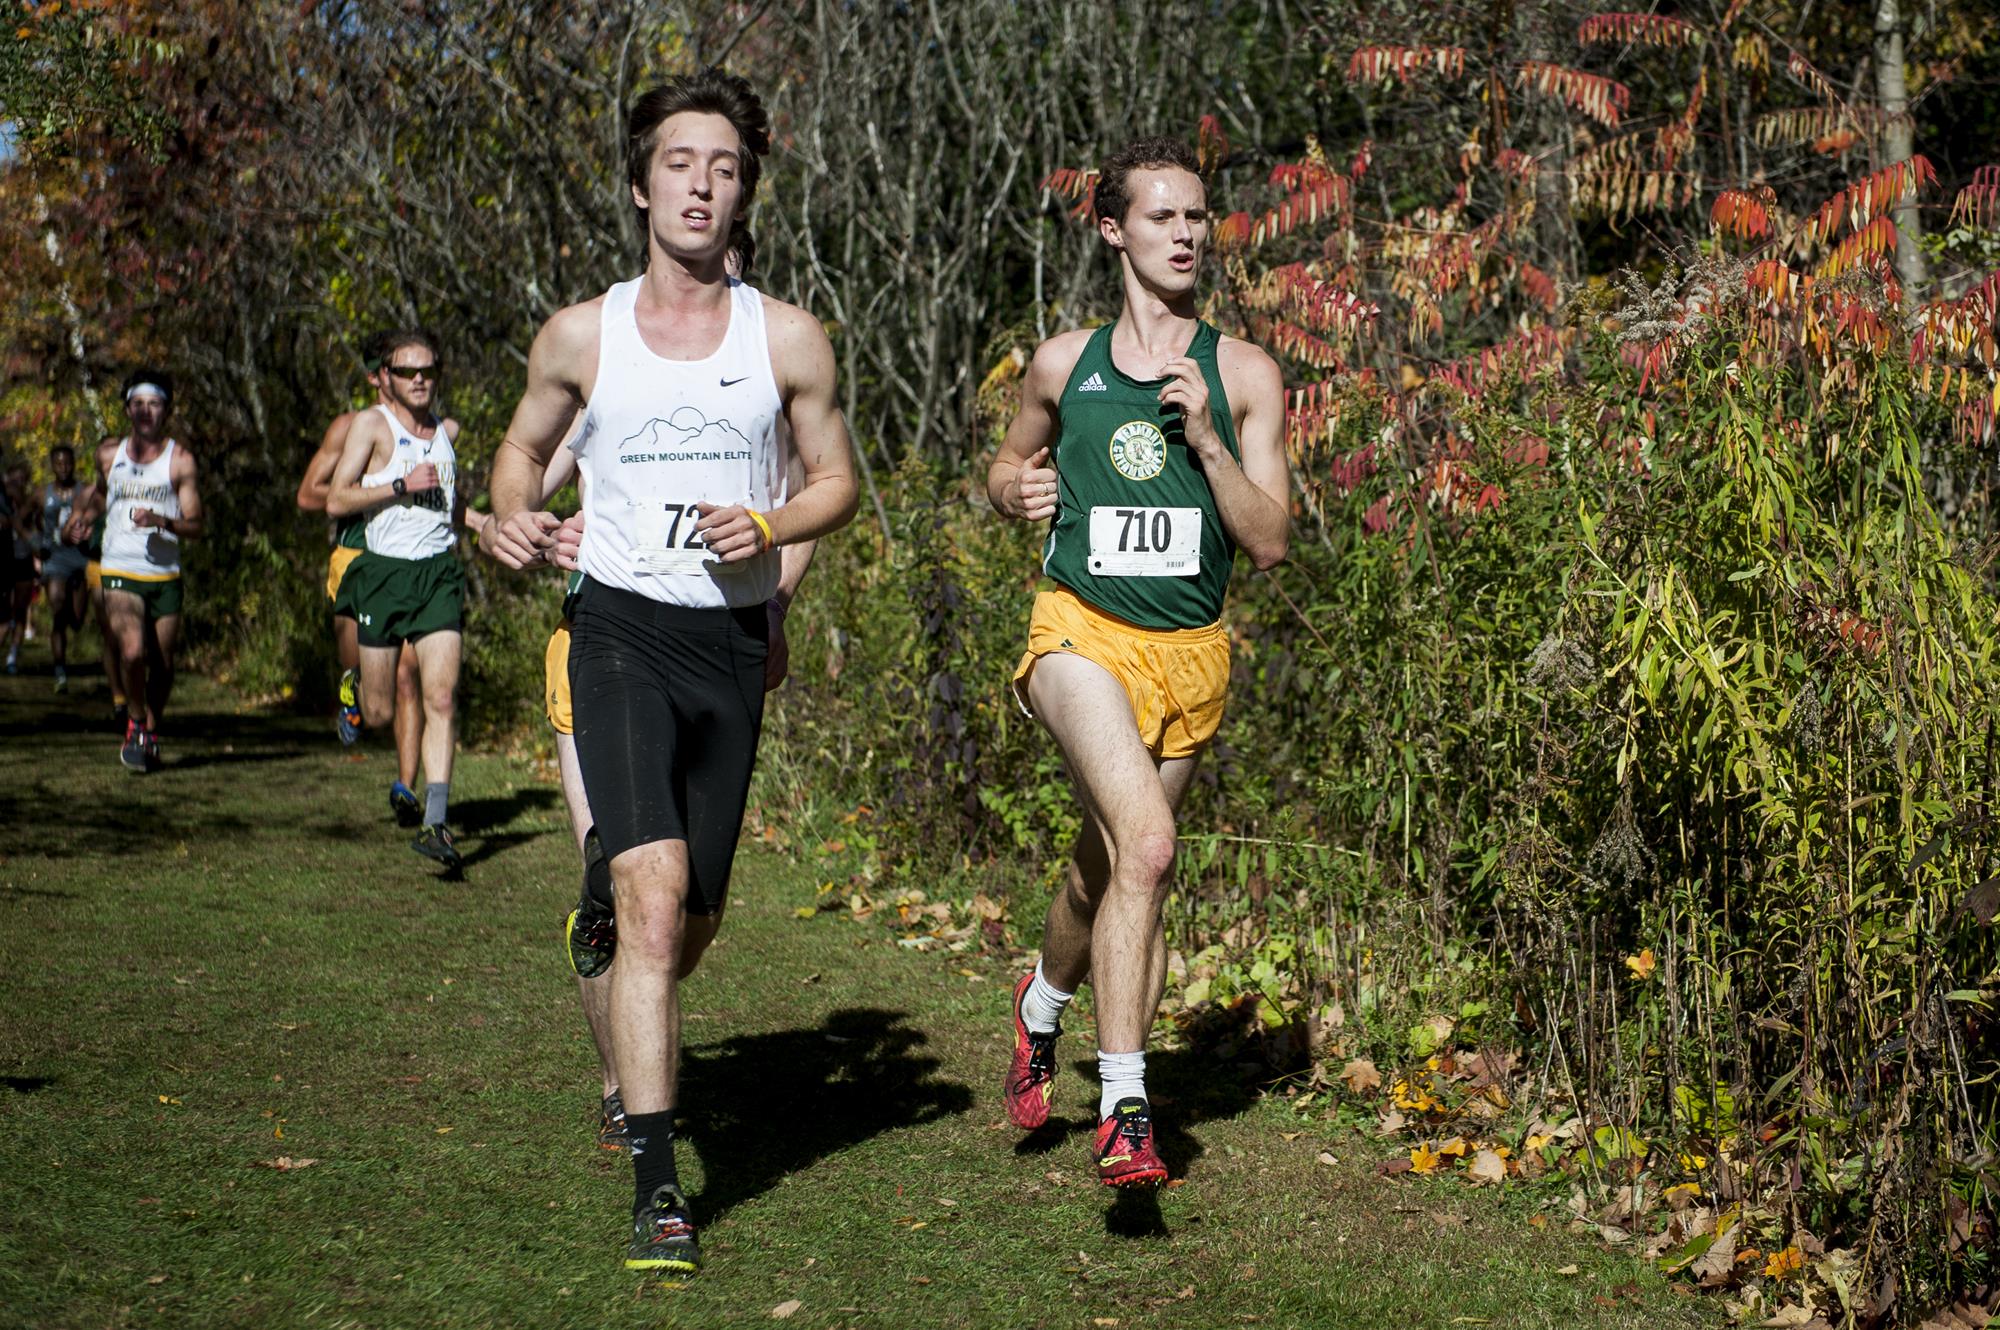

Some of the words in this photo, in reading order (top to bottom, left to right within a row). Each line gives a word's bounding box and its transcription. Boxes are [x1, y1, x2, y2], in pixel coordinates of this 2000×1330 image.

[1078, 384, 1107, 392] adidas
[620, 454, 656, 464] GREEN
[658, 451, 721, 462] MOUNTAIN
[724, 451, 752, 460] ELITE
[665, 503, 711, 550] 72
[1116, 509, 1172, 553] 710
